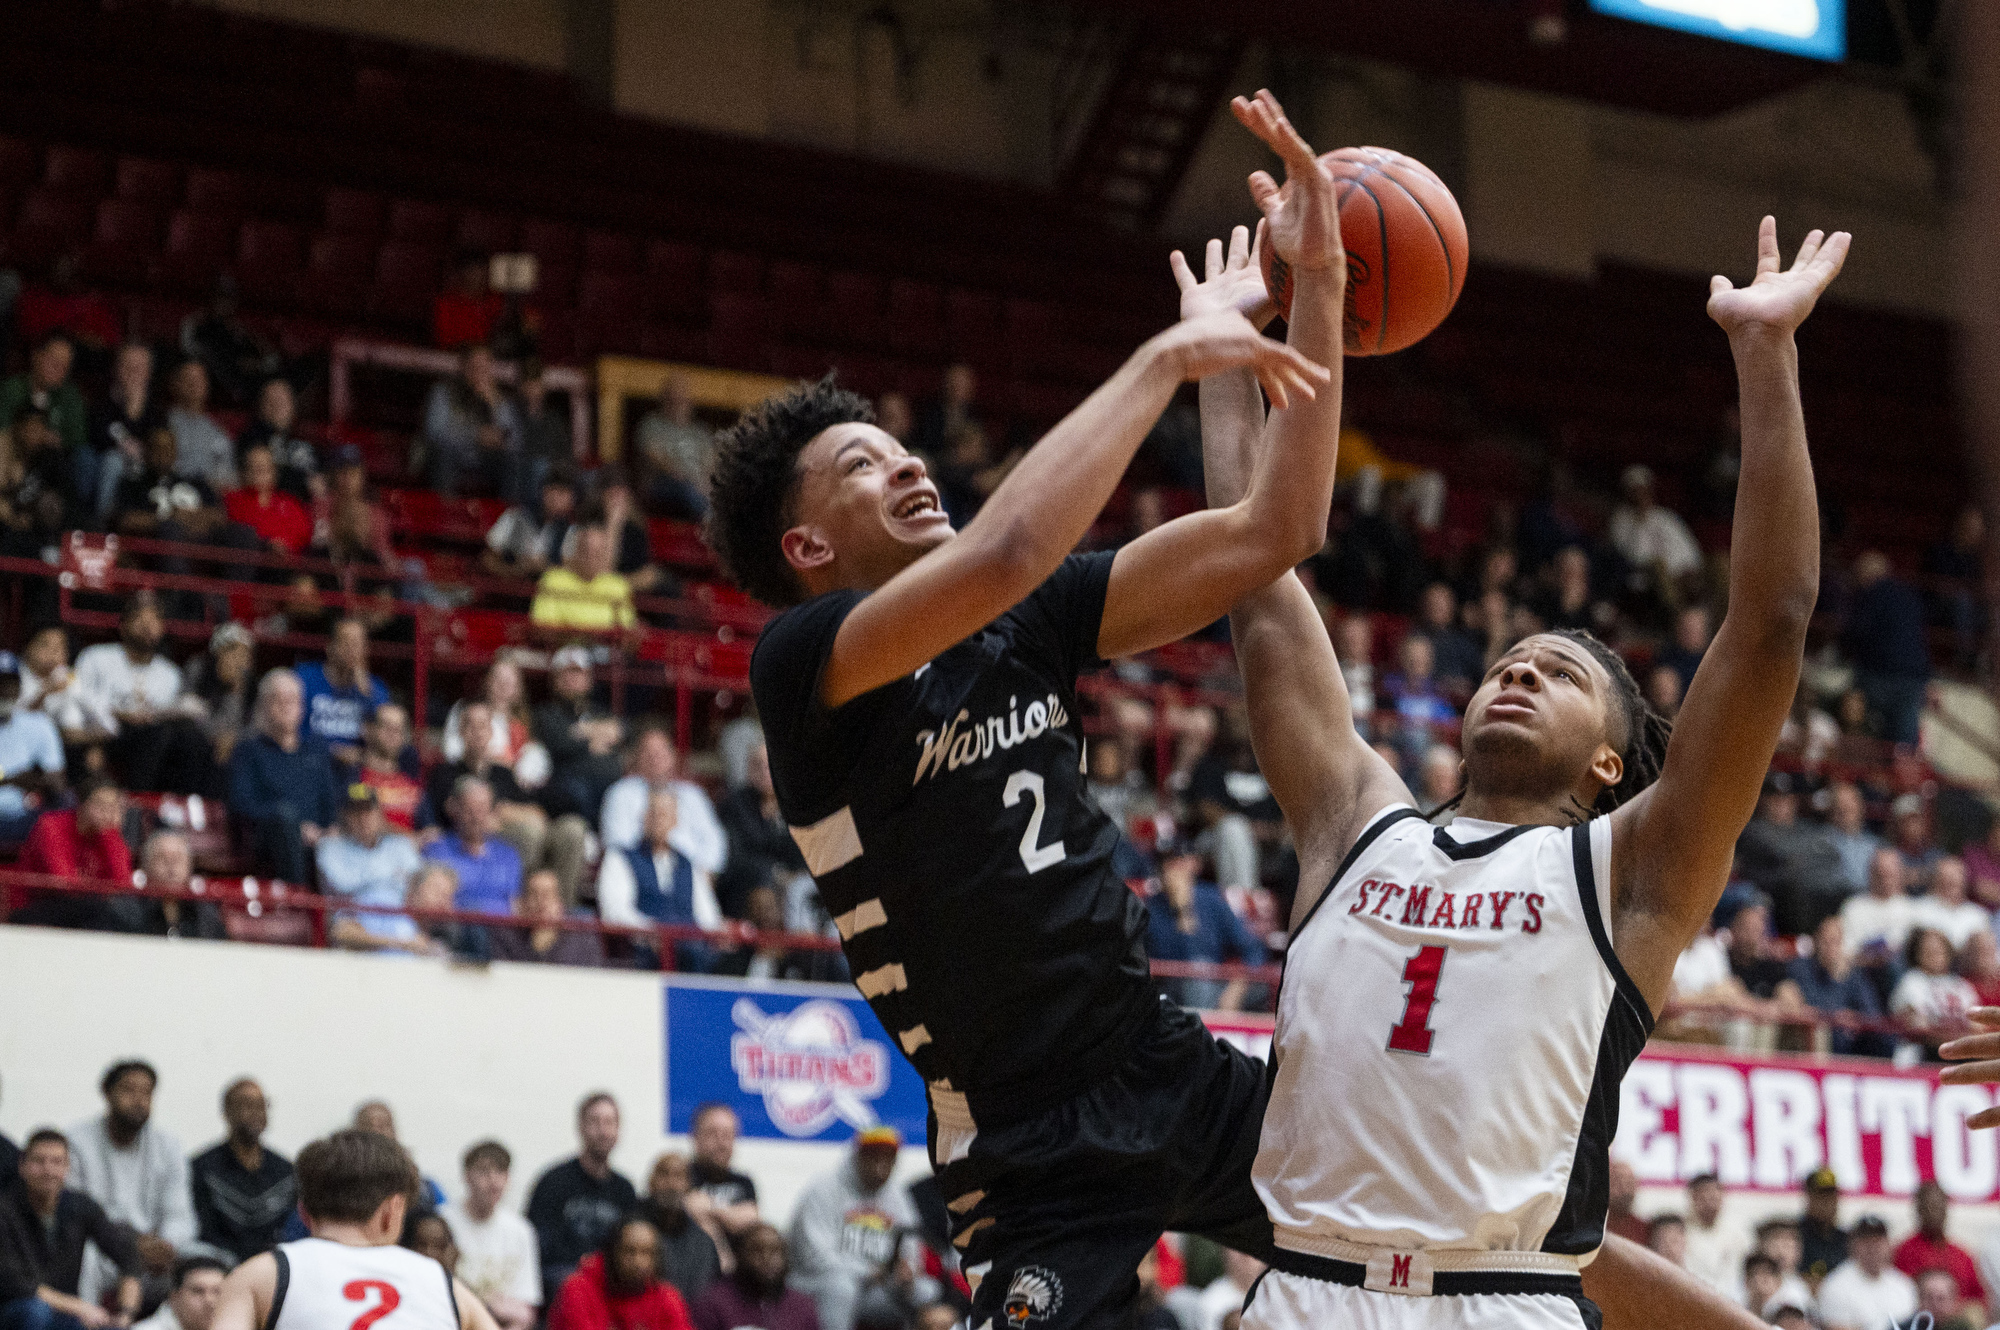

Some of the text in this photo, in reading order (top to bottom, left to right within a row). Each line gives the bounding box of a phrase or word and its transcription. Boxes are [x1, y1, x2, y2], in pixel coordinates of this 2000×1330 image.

[913, 692, 1069, 787] Warriors
[1002, 769, 1067, 875] 2
[1384, 943, 1449, 1057] 1
[1609, 1060, 2000, 1199] ERRITO
[342, 1279, 402, 1330] 2
[1389, 1253, 1413, 1288] M
